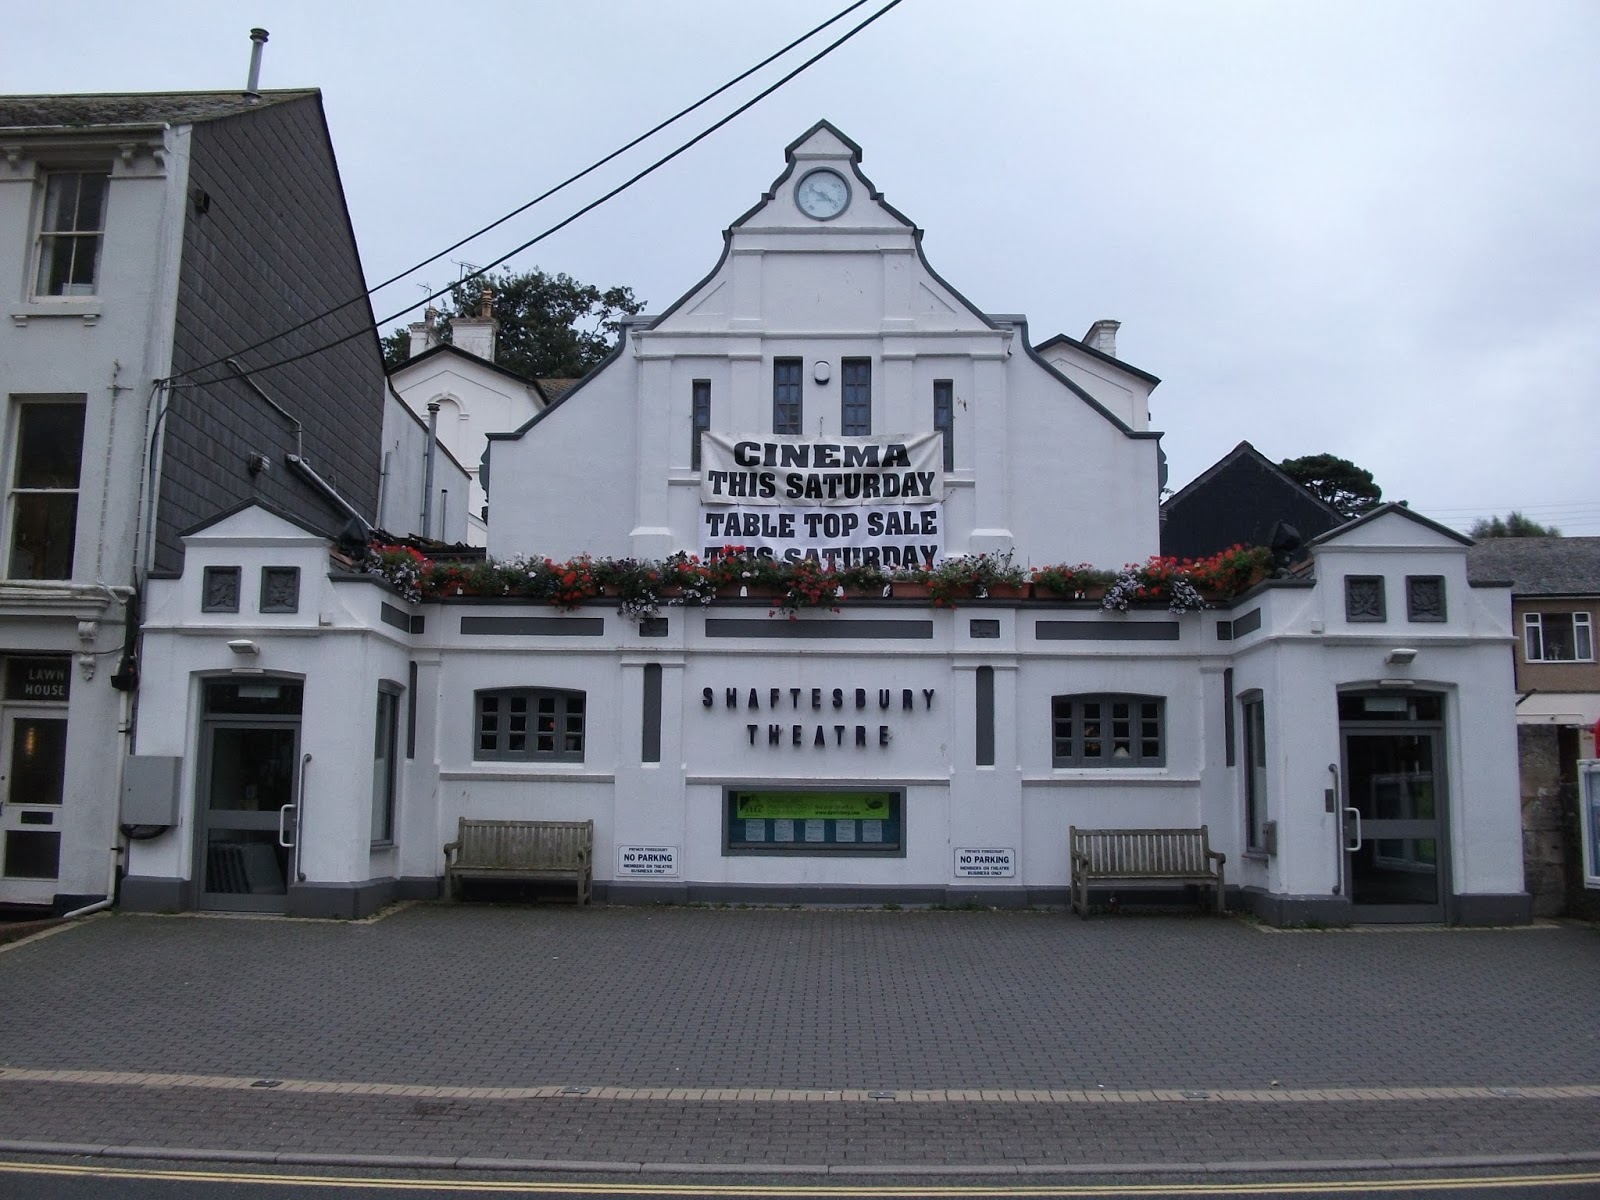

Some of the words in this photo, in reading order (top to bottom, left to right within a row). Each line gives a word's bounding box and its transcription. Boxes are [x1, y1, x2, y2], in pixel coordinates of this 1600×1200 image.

[734, 441, 911, 468] CINEMA
[708, 470, 776, 498] THIS
[786, 472, 935, 499] SATURDAY
[706, 512, 795, 538] TABLE
[804, 513, 858, 538] TOP
[867, 510, 938, 536] SALE
[29, 669, 65, 679] LAWN
[25, 684, 65, 696] HOUSE
[702, 687, 935, 709] SHAFTESBURY
[747, 724, 889, 746] THEATRE
[624, 853, 635, 861] NO
[638, 854, 672, 862] PARKING
